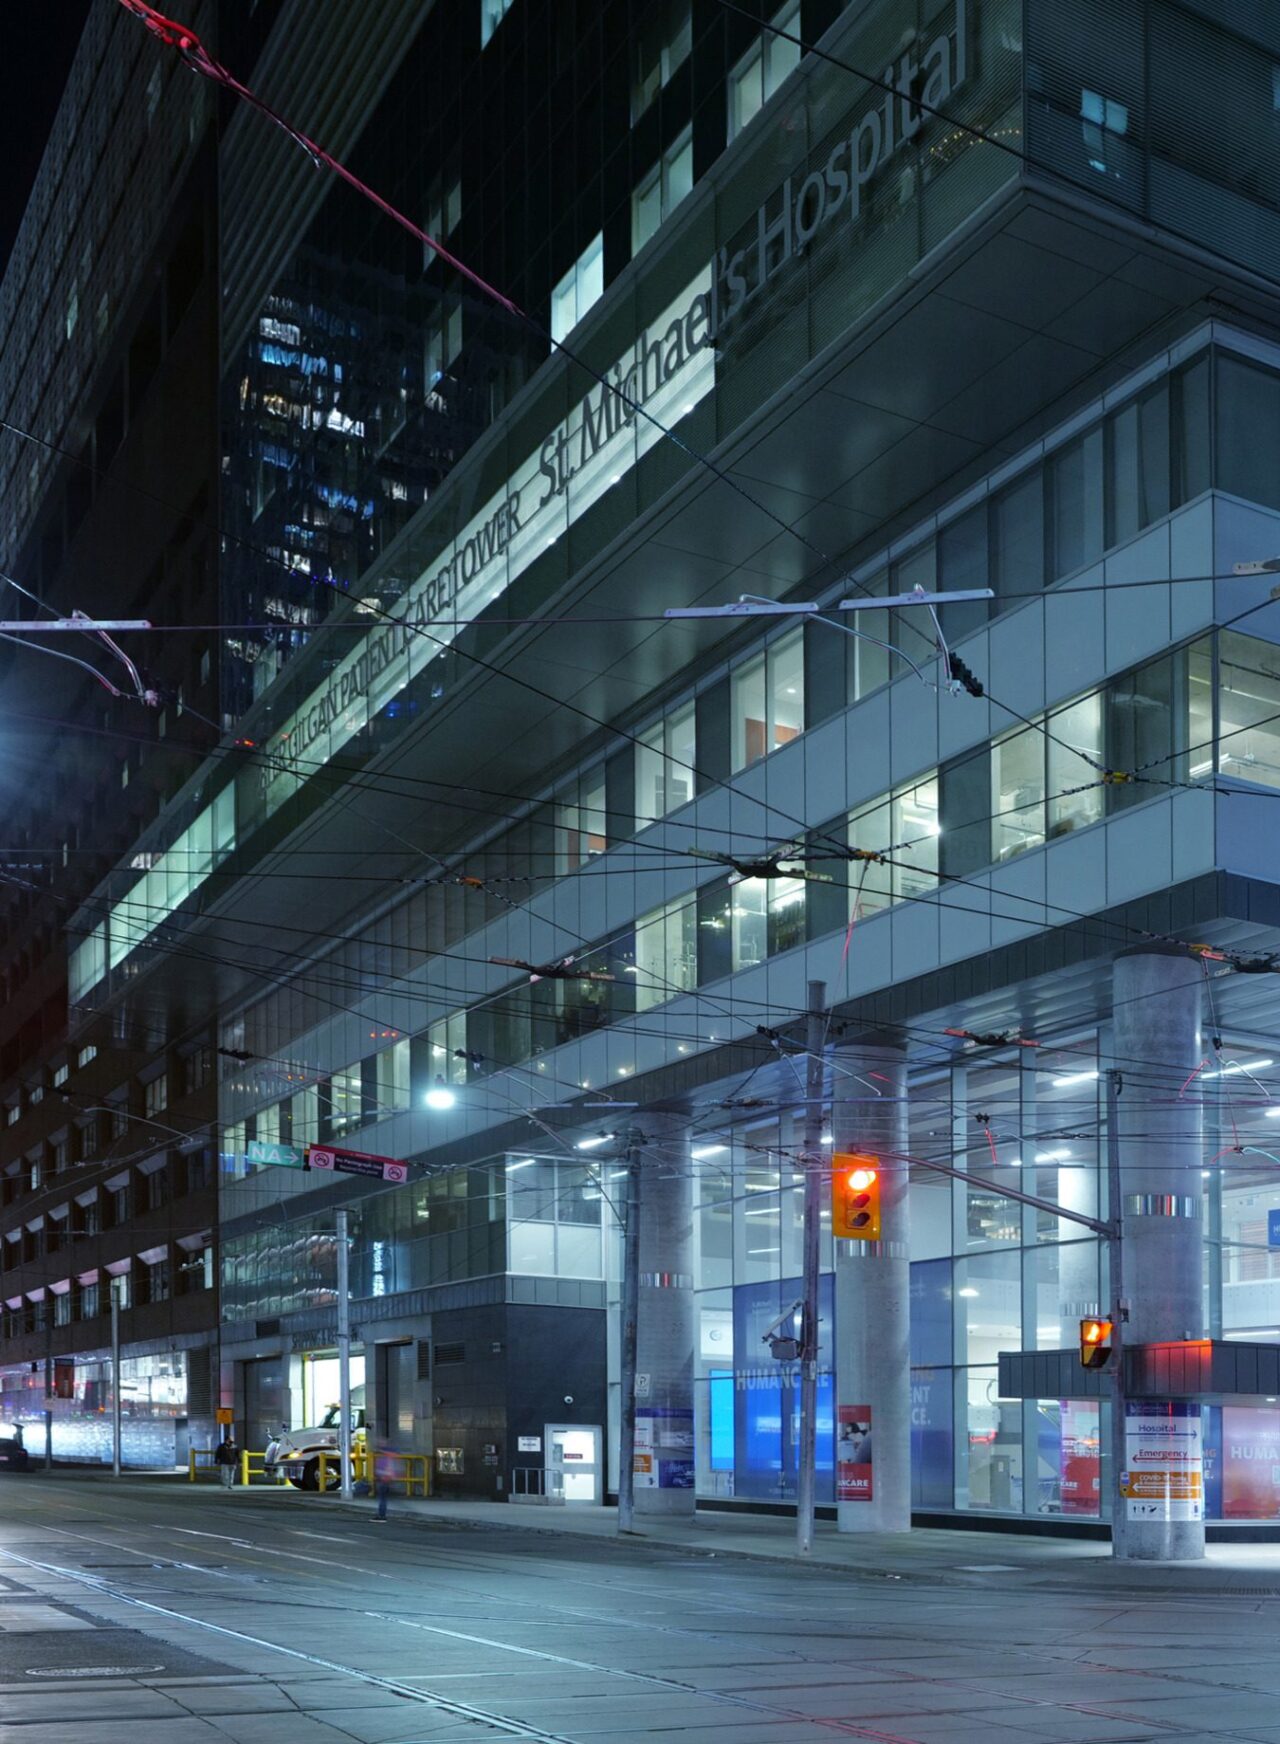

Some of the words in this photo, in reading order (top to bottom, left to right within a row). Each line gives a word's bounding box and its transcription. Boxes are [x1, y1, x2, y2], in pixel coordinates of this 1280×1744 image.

[540, 427, 575, 506] St.
[581, 246, 747, 467] Michael's
[758, 0, 966, 286] Hospital
[289, 682, 337, 767] GILGAN
[341, 622, 400, 712] PATIENT
[401, 566, 451, 651] CARE
[451, 490, 522, 594] TOWER
[1138, 1424, 1177, 1434] Hospital
[1139, 1449, 1188, 1458] Emergency
